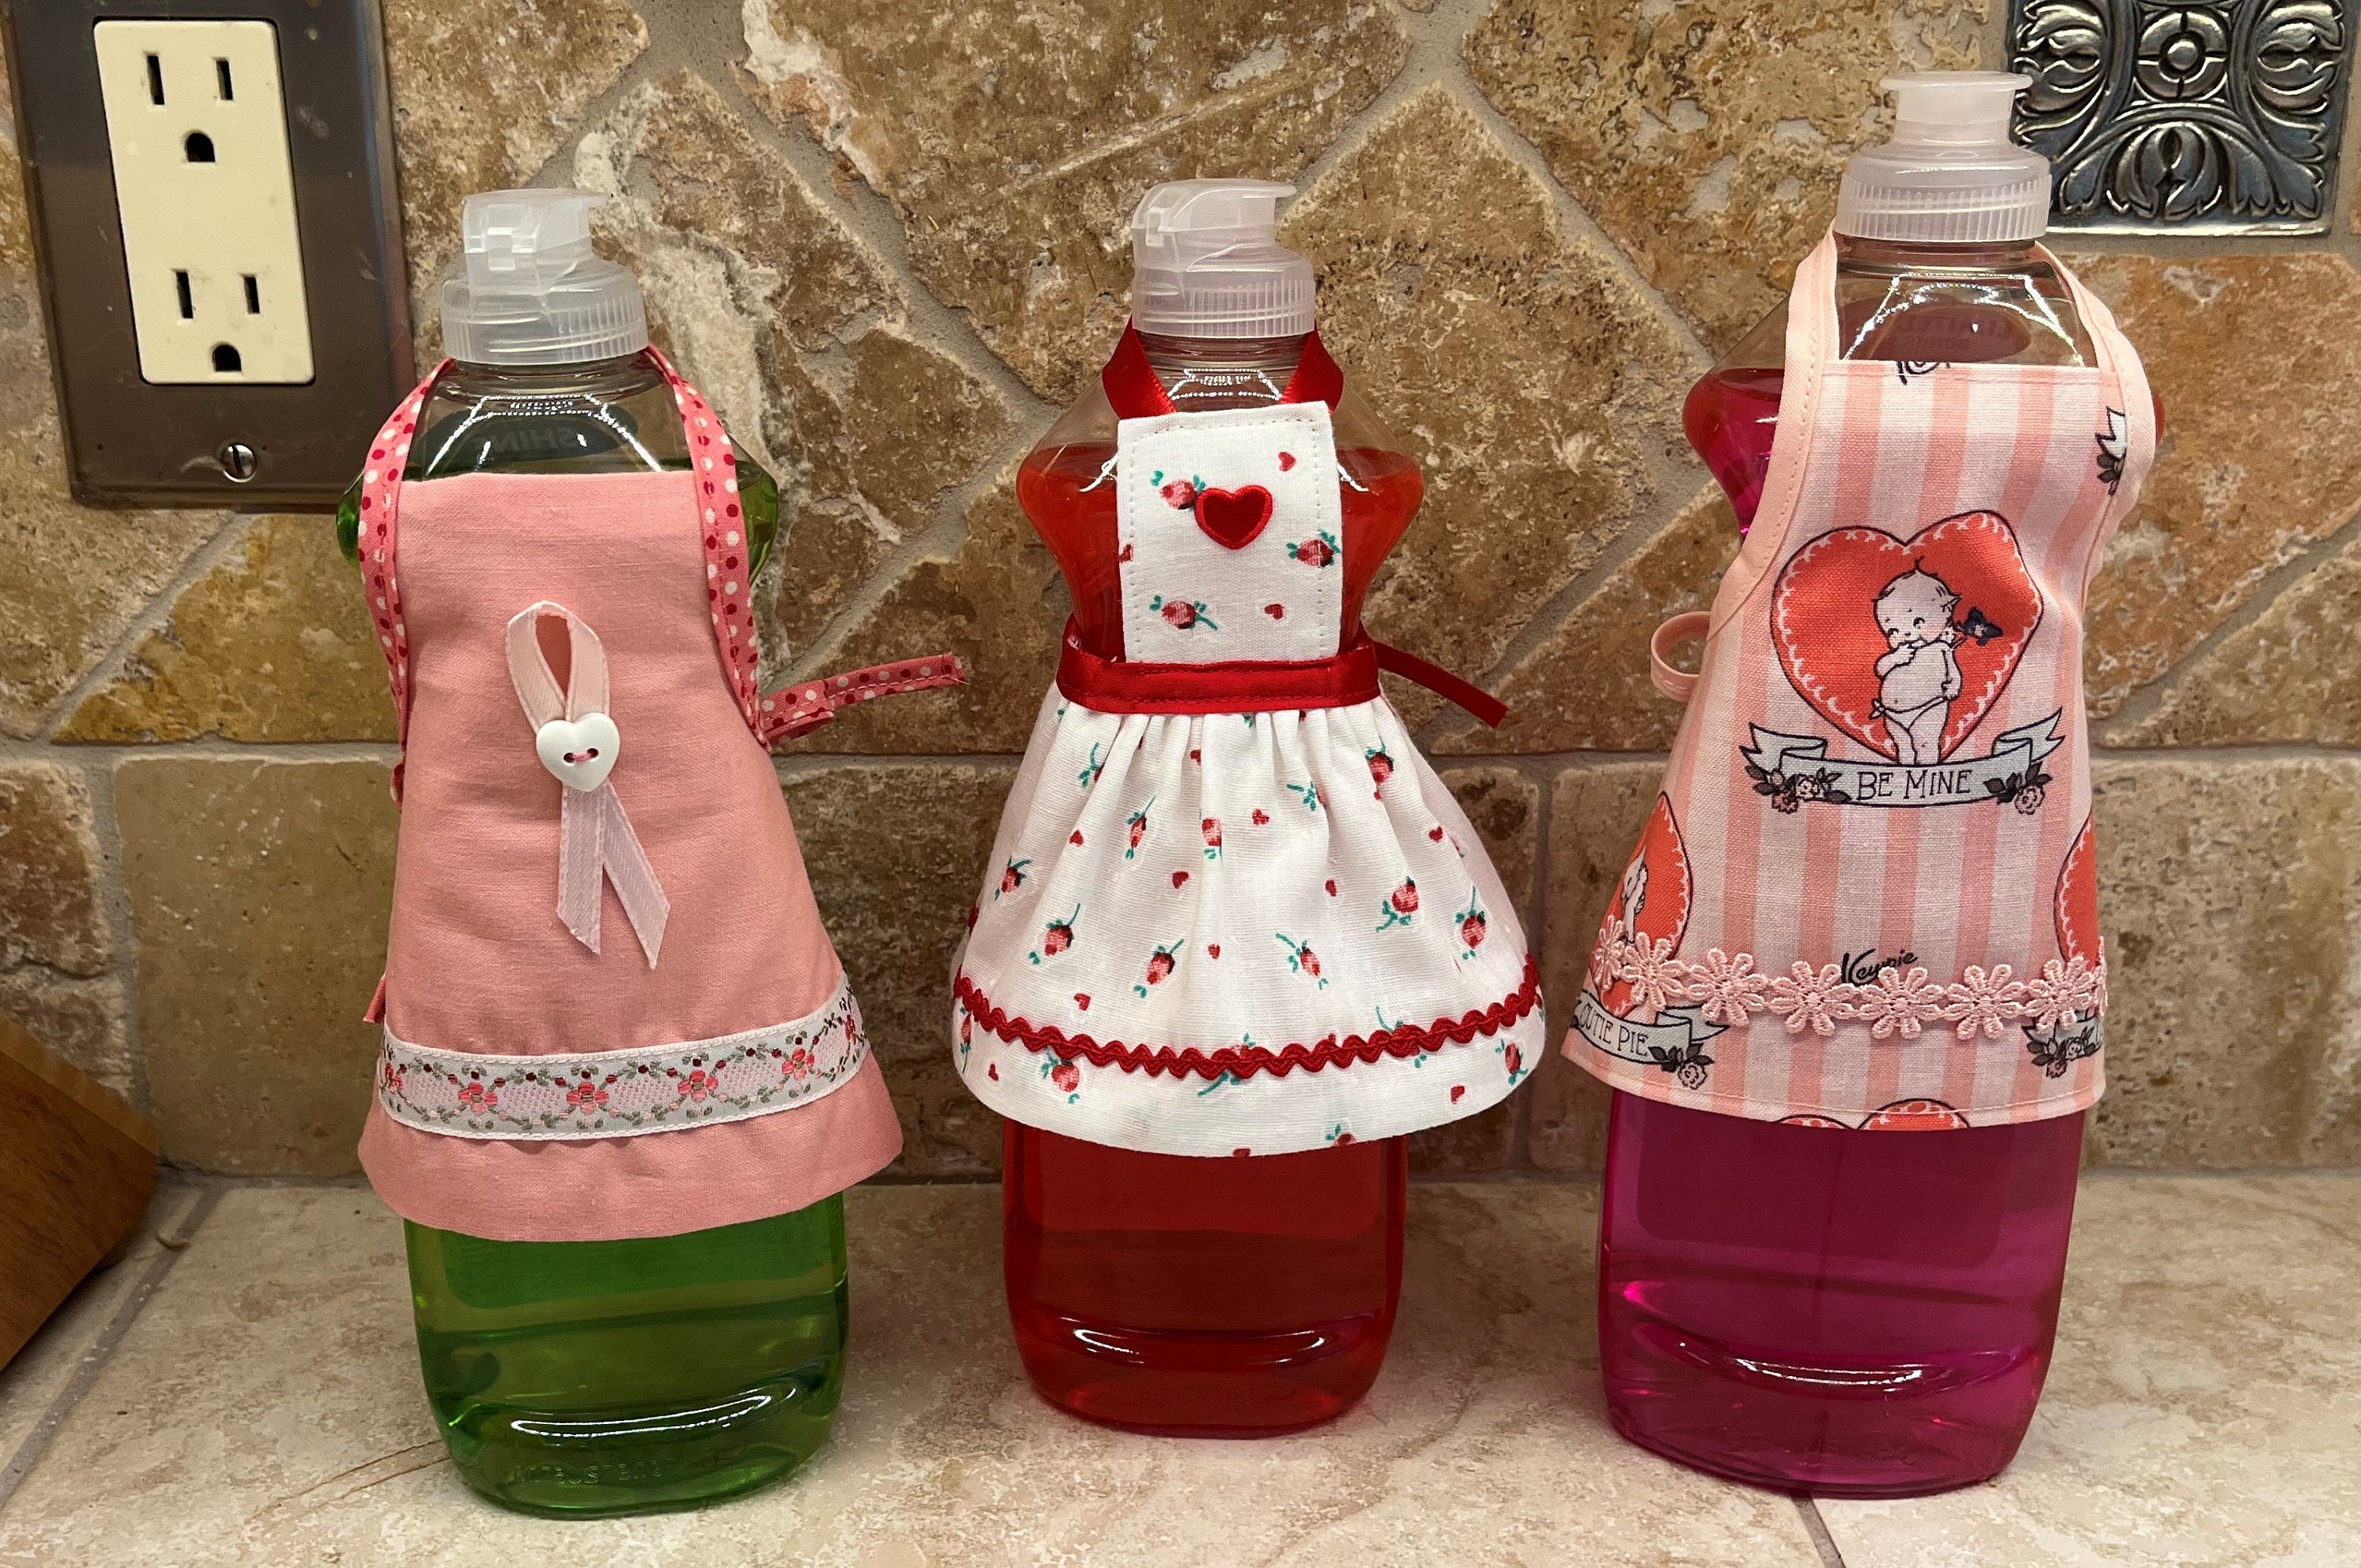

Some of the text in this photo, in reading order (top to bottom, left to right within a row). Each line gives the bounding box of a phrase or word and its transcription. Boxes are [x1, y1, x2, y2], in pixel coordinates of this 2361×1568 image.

[1855, 769, 1973, 801] BE MINE
[1616, 1024, 1650, 1057] PIE
